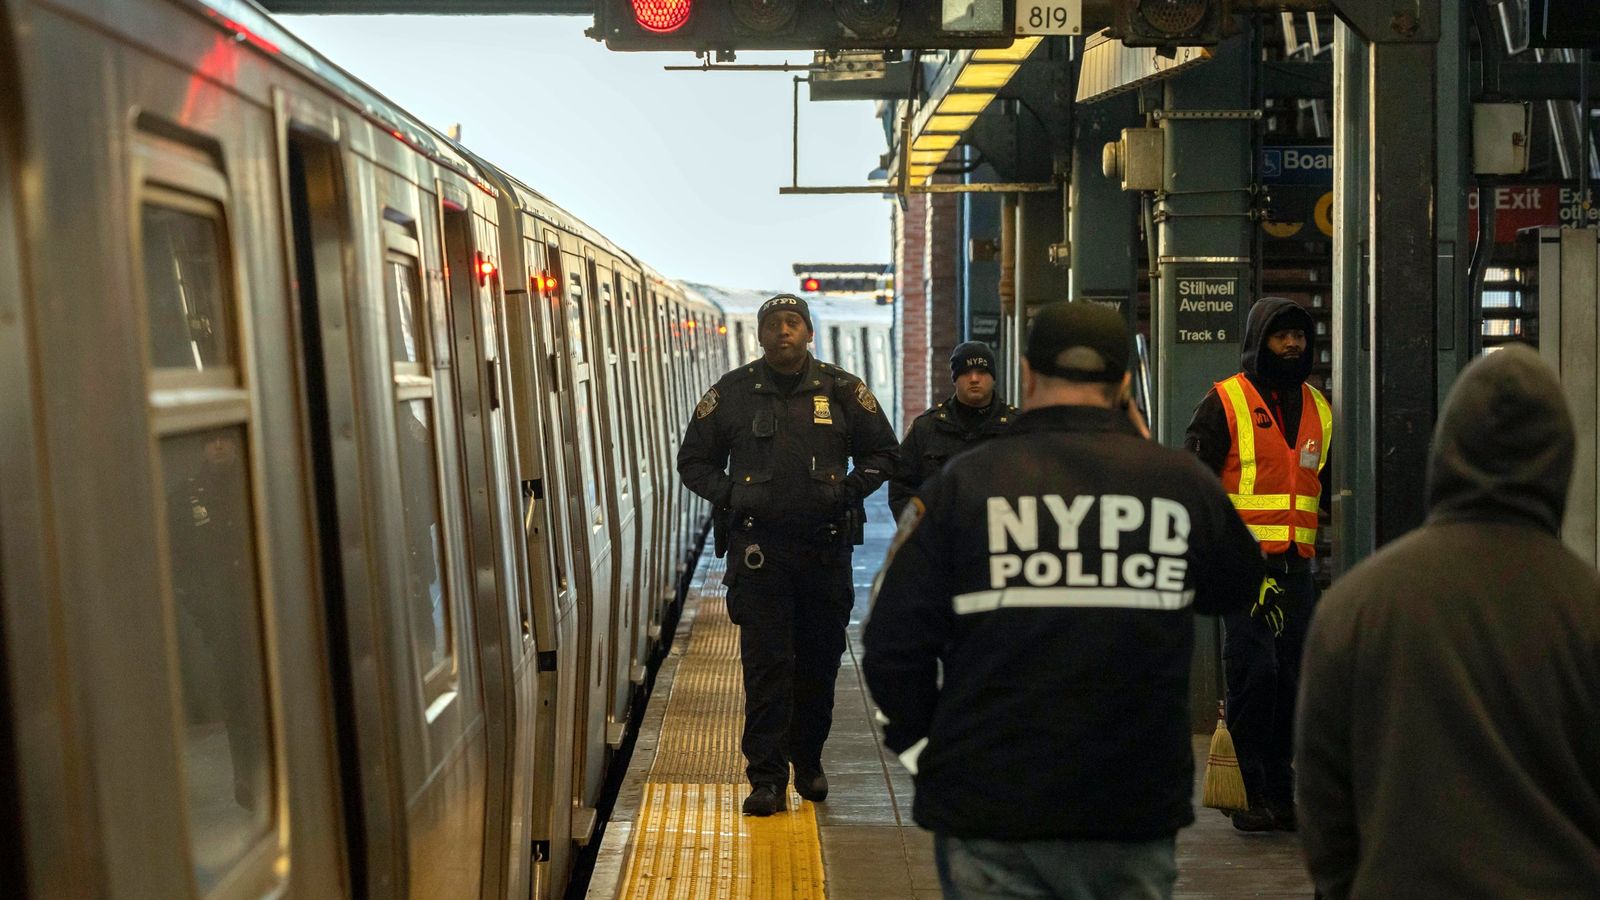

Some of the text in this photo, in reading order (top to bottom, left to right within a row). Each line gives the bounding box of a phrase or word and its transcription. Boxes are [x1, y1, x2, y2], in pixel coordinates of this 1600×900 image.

[1029, 6, 1067, 28] 819
[1495, 188, 1541, 209] Exit
[1560, 188, 1593, 203] Ext
[1560, 204, 1600, 220] ote
[1179, 281, 1234, 295] Stillwell
[763, 298, 797, 311] NYPD
[1180, 298, 1234, 312] Avenue
[1179, 329, 1226, 341] Track 6
[987, 494, 1192, 555] NYPD
[989, 552, 1188, 592] POLICE
